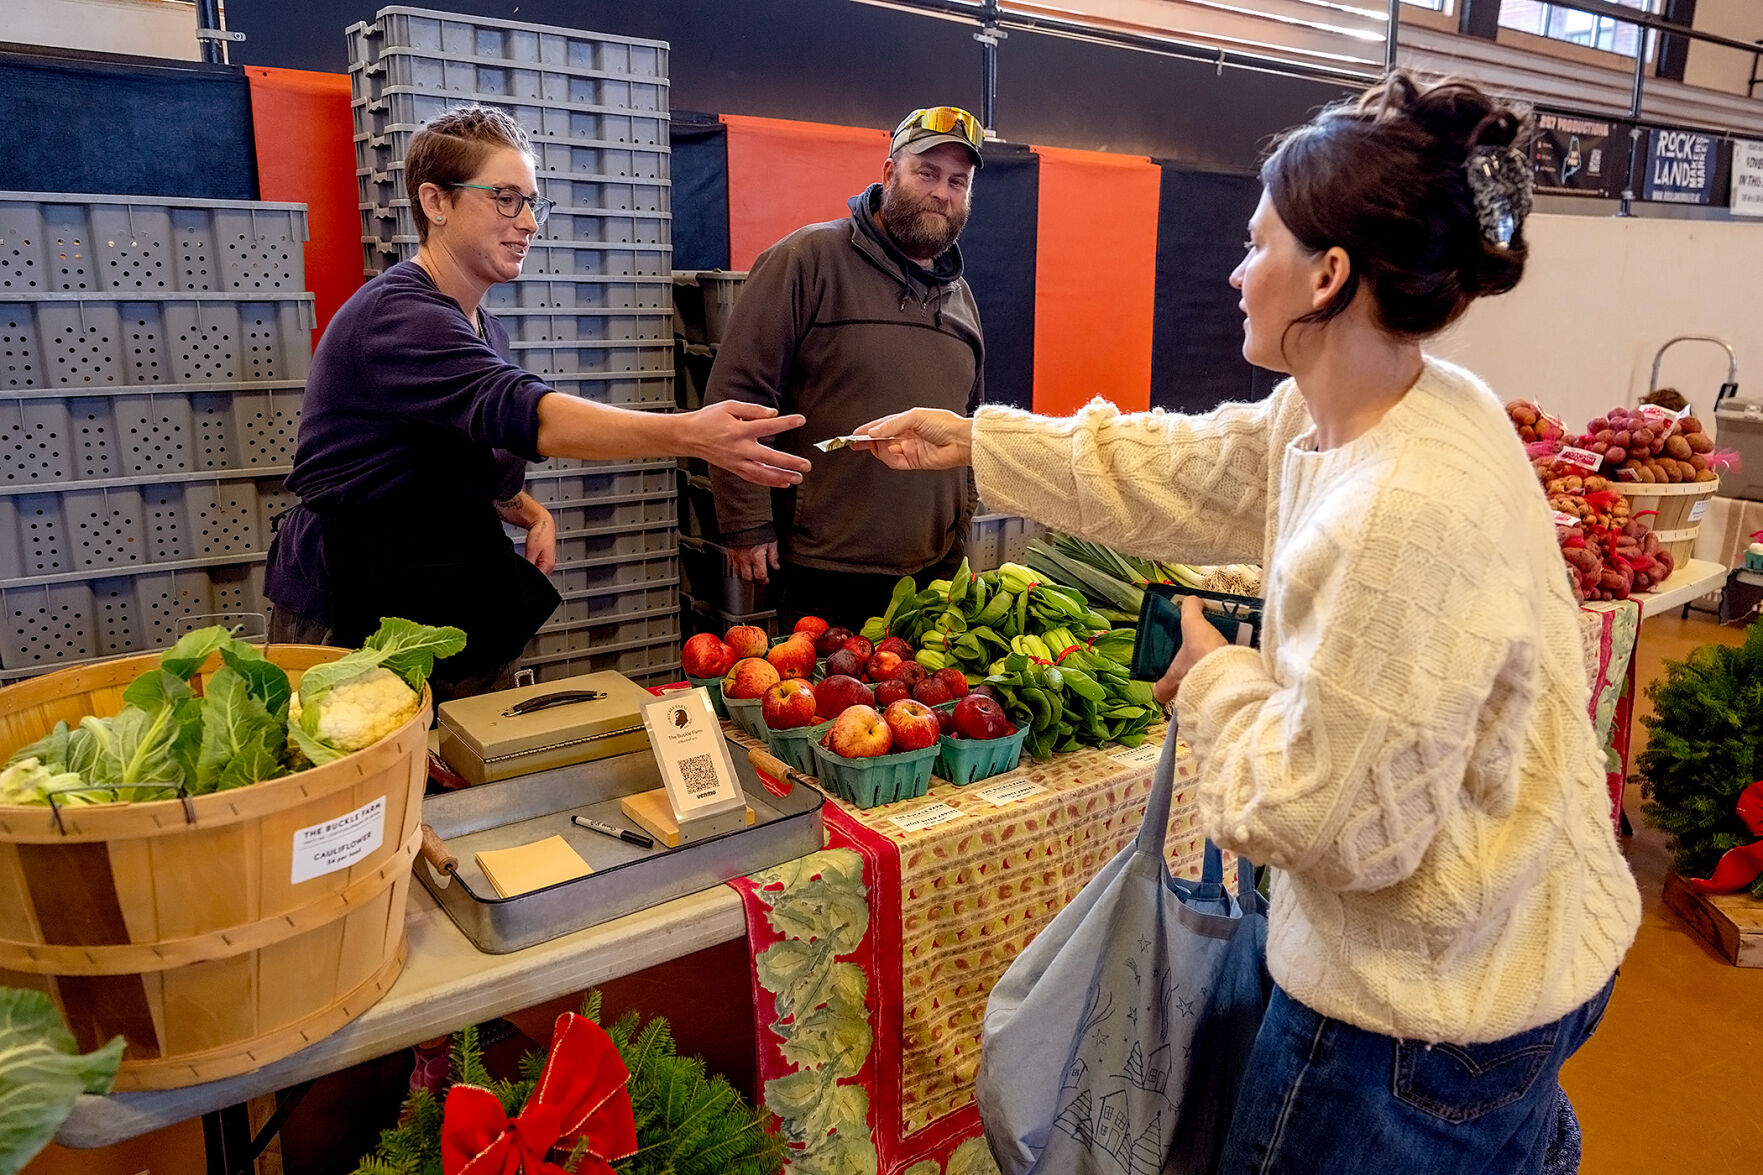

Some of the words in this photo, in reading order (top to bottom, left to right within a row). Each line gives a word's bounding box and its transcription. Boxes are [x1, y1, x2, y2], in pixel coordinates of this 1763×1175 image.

[1656, 130, 1696, 159] ROCK
[1654, 160, 1690, 187] LAND
[1689, 136, 1704, 188] MAKERS
[1697, 138, 1710, 188] MARKET
[696, 790, 716, 799] venmo
[304, 828, 322, 838] THE
[326, 814, 359, 832] BUCKLE
[361, 802, 381, 817] FARM
[313, 832, 372, 861] CAULIFLOWER
[337, 855, 347, 863] per
